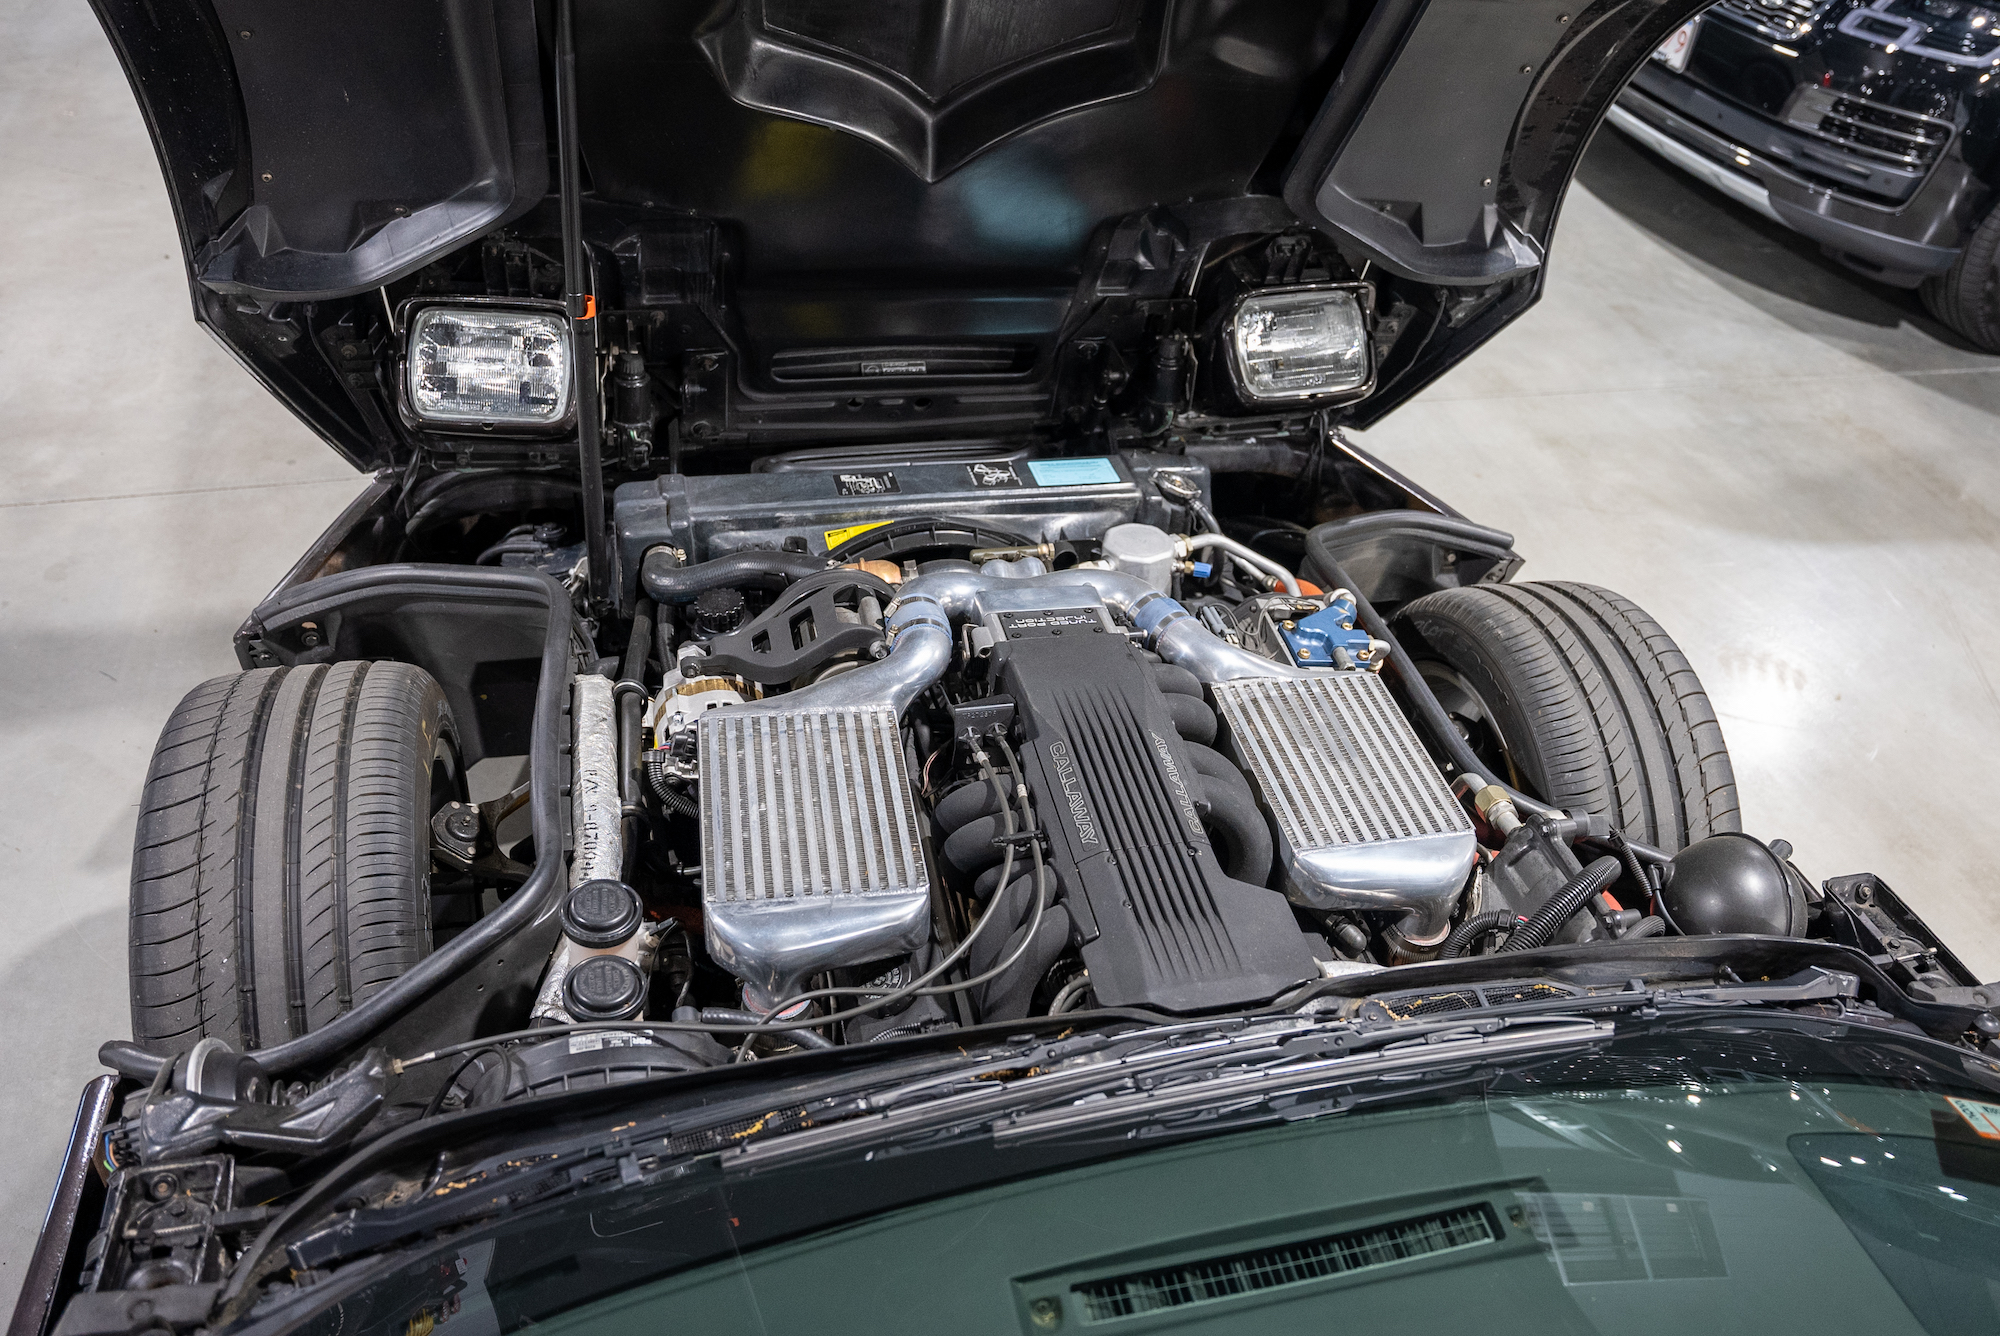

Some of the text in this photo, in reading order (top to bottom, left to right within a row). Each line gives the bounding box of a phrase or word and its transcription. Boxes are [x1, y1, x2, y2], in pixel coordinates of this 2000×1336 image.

[1015, 614, 1087, 624] INJECTION
[1050, 618, 1098, 626] TUNED
[1050, 741, 1099, 844] CALLAWAY
[1149, 730, 1204, 834] CALLAWAY
